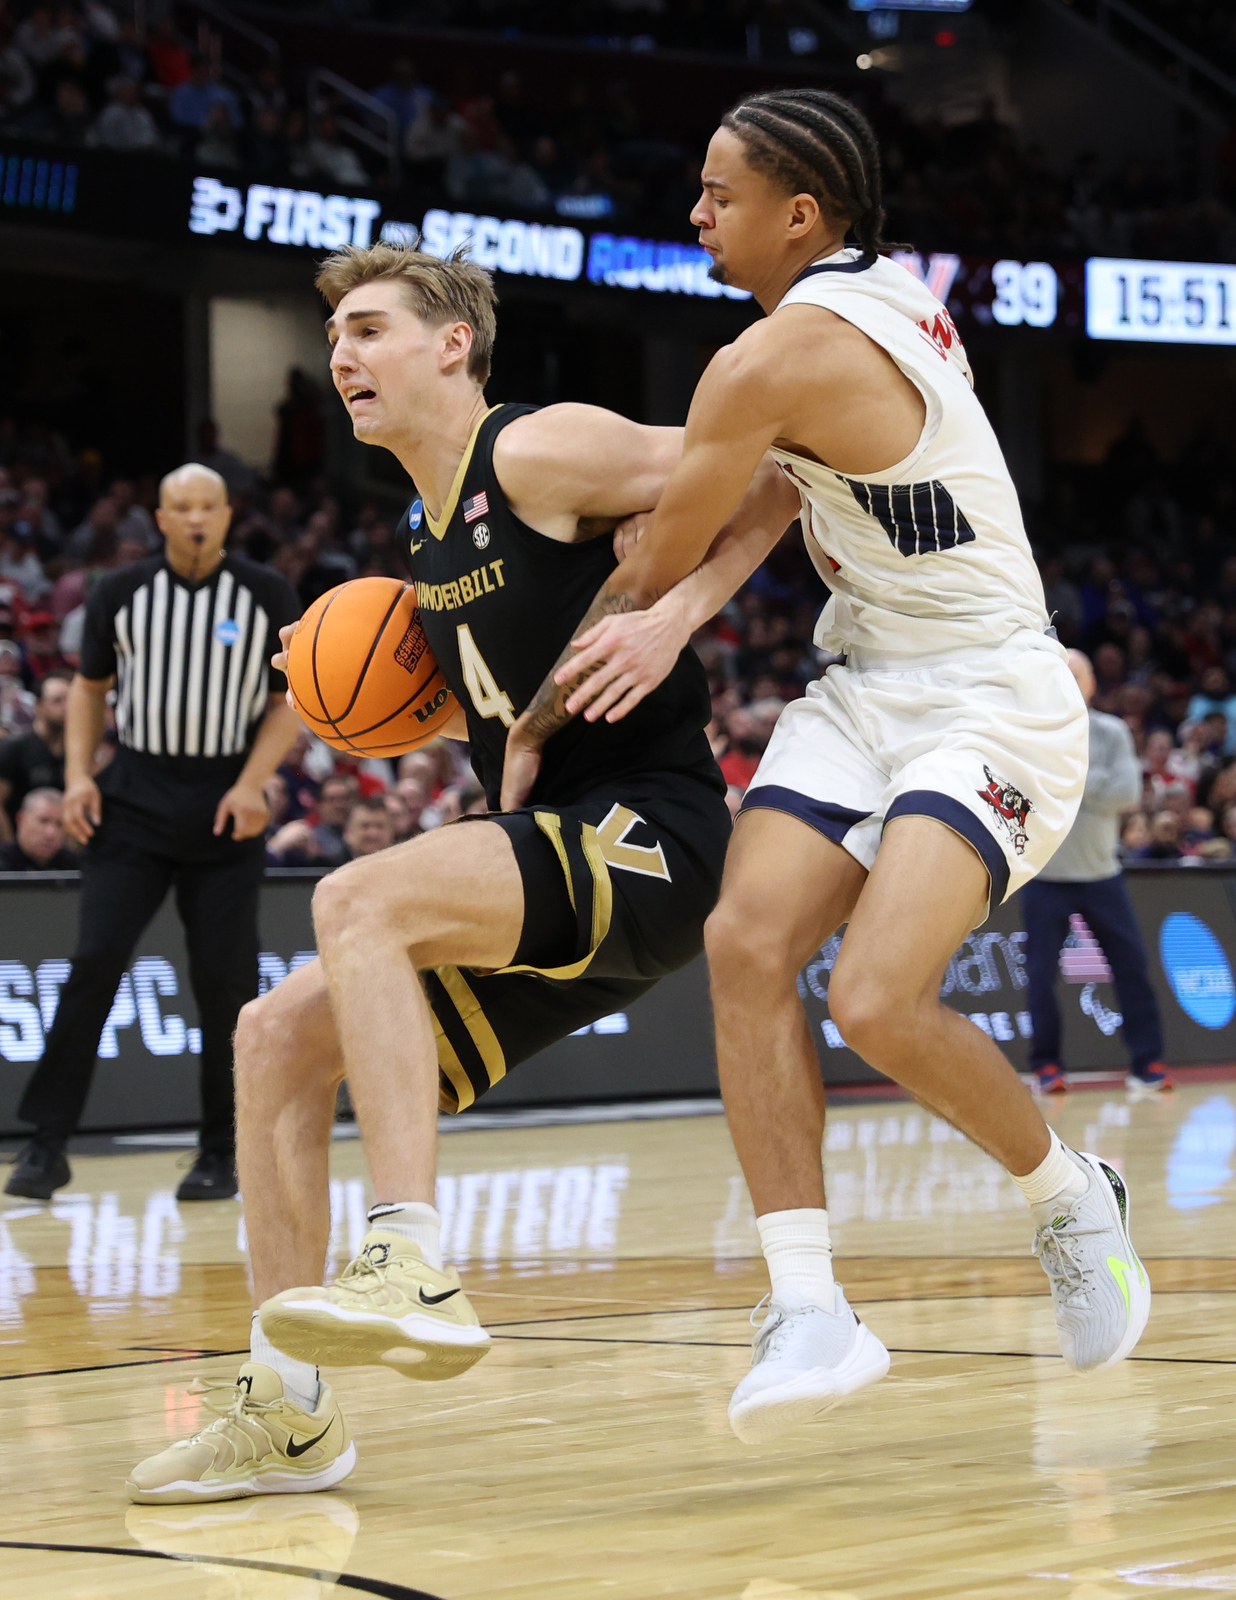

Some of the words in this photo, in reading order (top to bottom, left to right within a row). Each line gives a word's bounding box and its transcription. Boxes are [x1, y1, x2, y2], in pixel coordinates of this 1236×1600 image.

[243, 184, 382, 250] FIRST
[420, 208, 584, 281] SECOND
[586, 232, 753, 300] ROUND
[992, 259, 1058, 328] 39
[473, 524, 490, 548] SEC
[414, 558, 505, 612] VANDERBILT
[396, 622, 422, 665] MADNESS
[456, 623, 517, 728] 4
